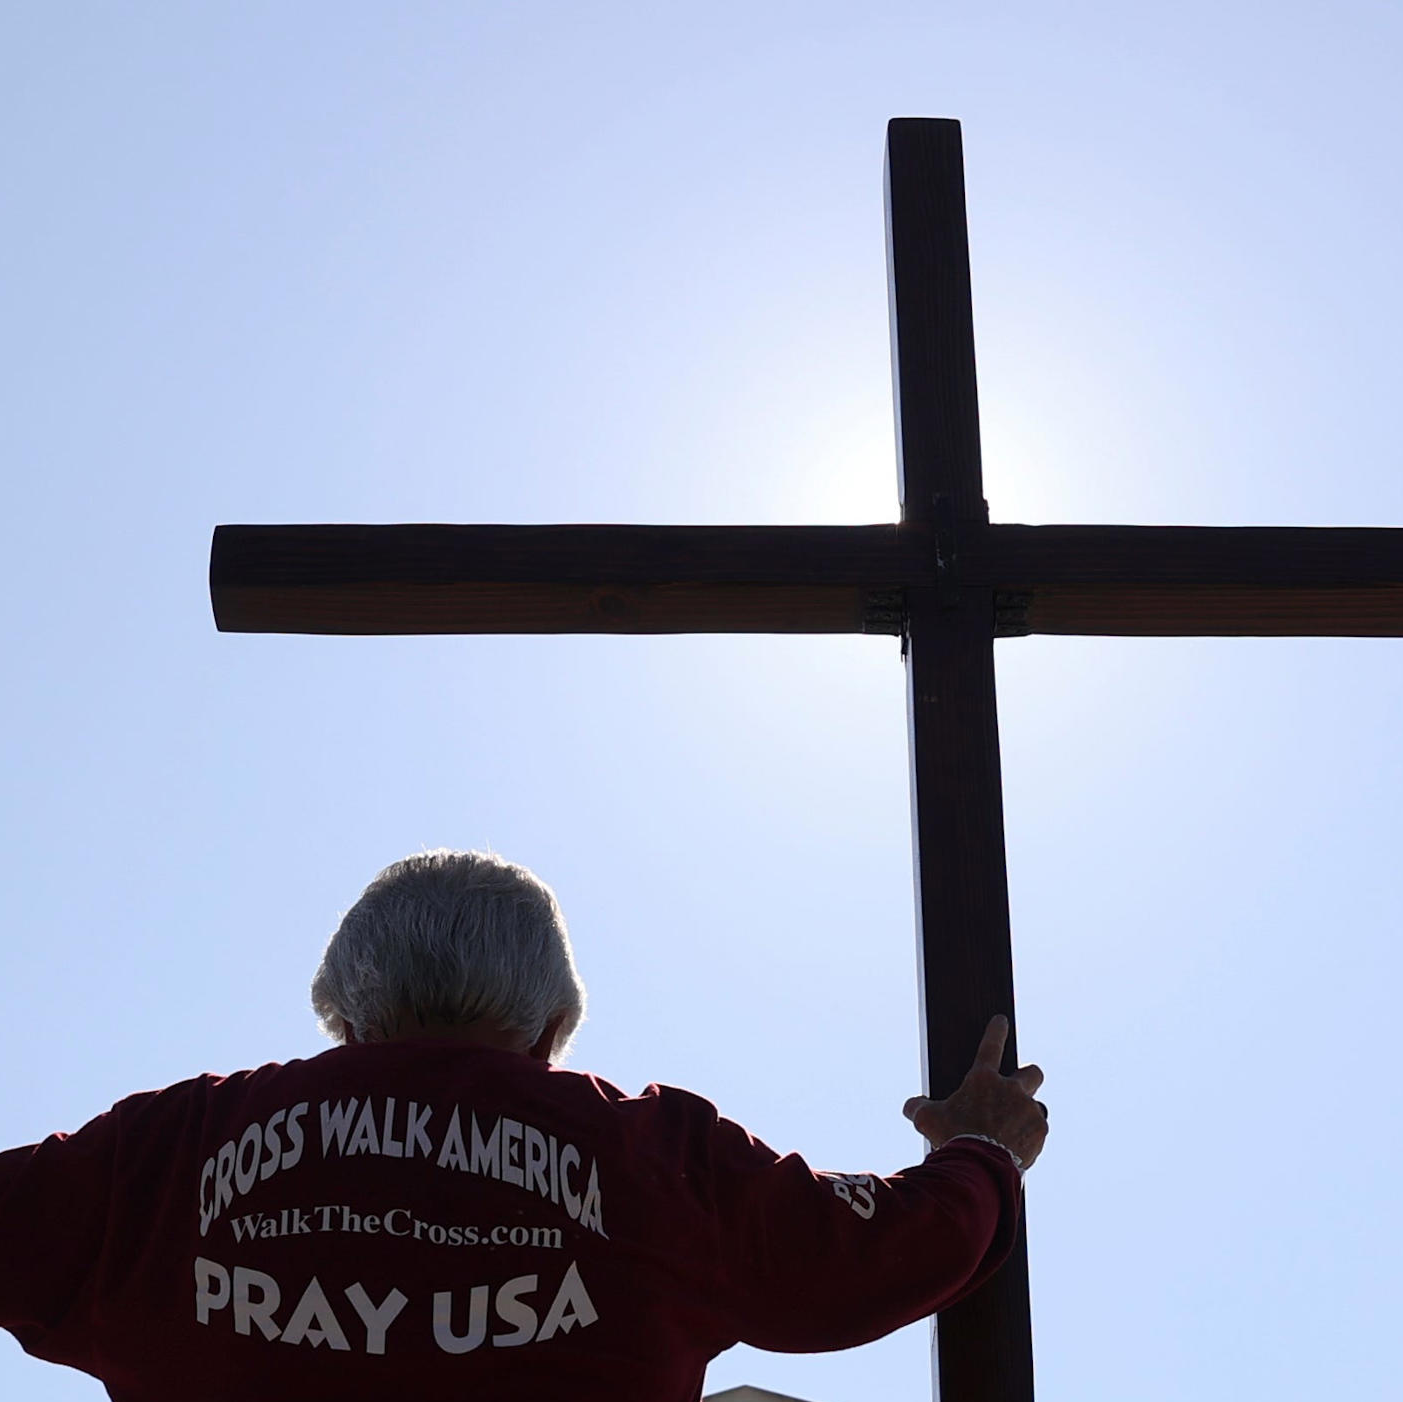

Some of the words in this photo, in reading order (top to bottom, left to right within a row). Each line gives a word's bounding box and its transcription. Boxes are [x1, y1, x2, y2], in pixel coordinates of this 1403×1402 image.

[199, 1101, 309, 1238] CROSS
[319, 1096, 433, 1159] WALK
[436, 1103, 610, 1240] AMERICA
[230, 1205, 563, 1249] WalkTheCross.com
[194, 1256, 409, 1355] PRAY
[432, 1260, 599, 1354] USA
